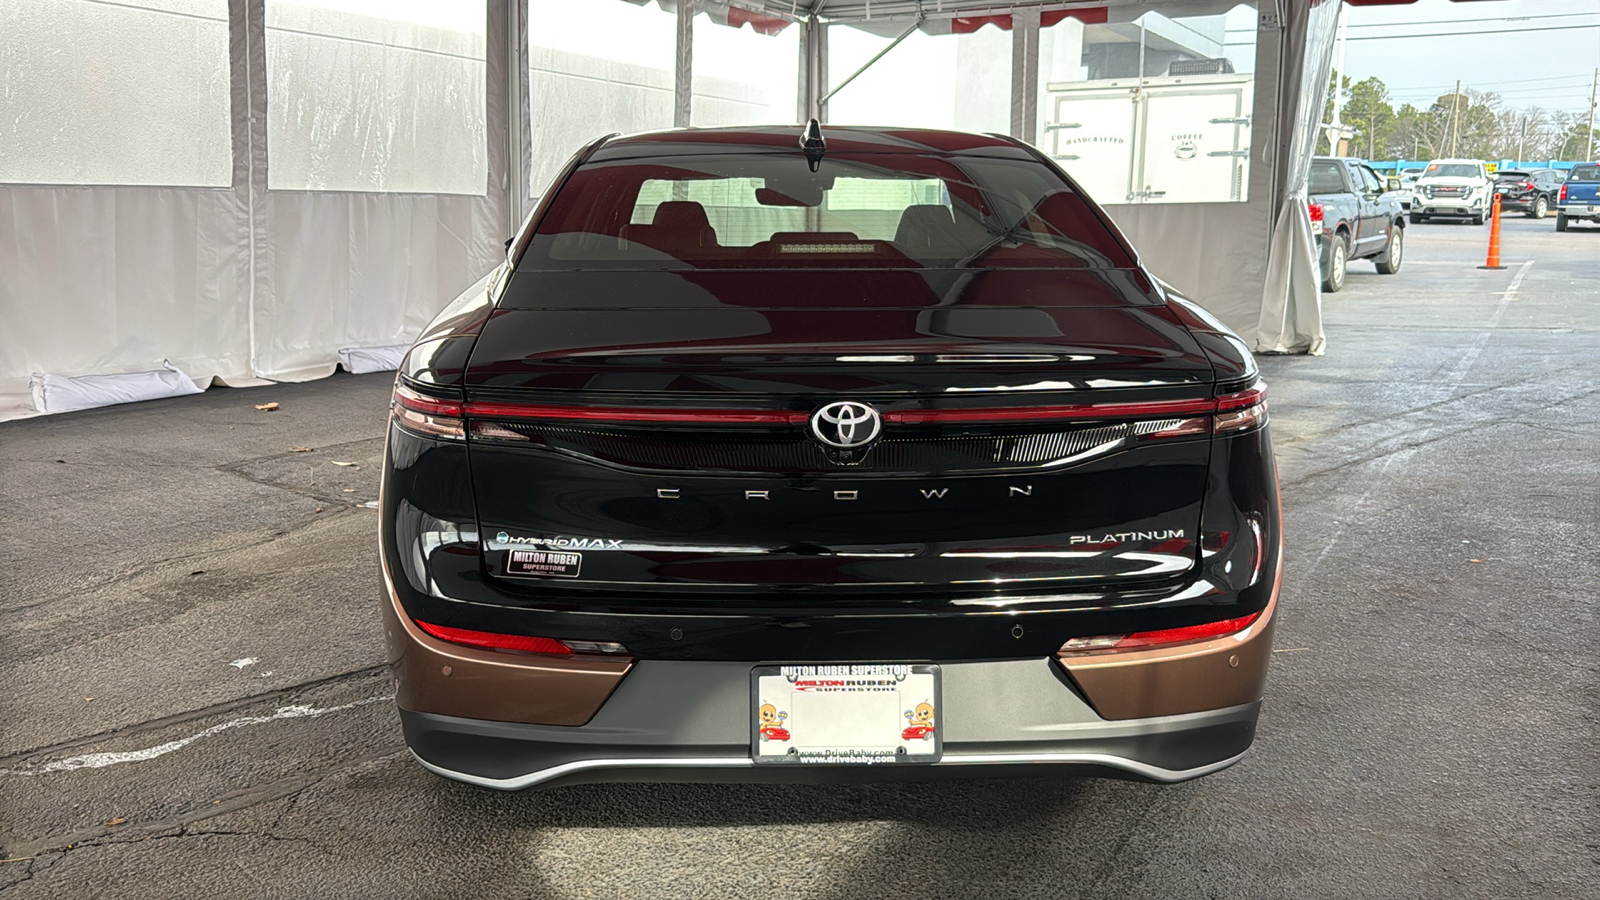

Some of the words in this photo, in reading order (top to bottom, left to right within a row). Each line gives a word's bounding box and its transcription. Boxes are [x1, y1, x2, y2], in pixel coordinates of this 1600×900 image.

[1171, 133, 1203, 141] COFFEE
[656, 484, 1033, 500] CROWN
[1069, 529, 1184, 545] PLATINUM
[513, 551, 546, 563] MILTON
[547, 554, 578, 565] RUBEN
[522, 563, 566, 571] SUPERSTORE
[780, 665, 816, 676] MILTON
[817, 665, 850, 676] RUBEN
[851, 665, 913, 675] SUPERSTORE
[800, 755, 896, 765] www.drivebaby.com
